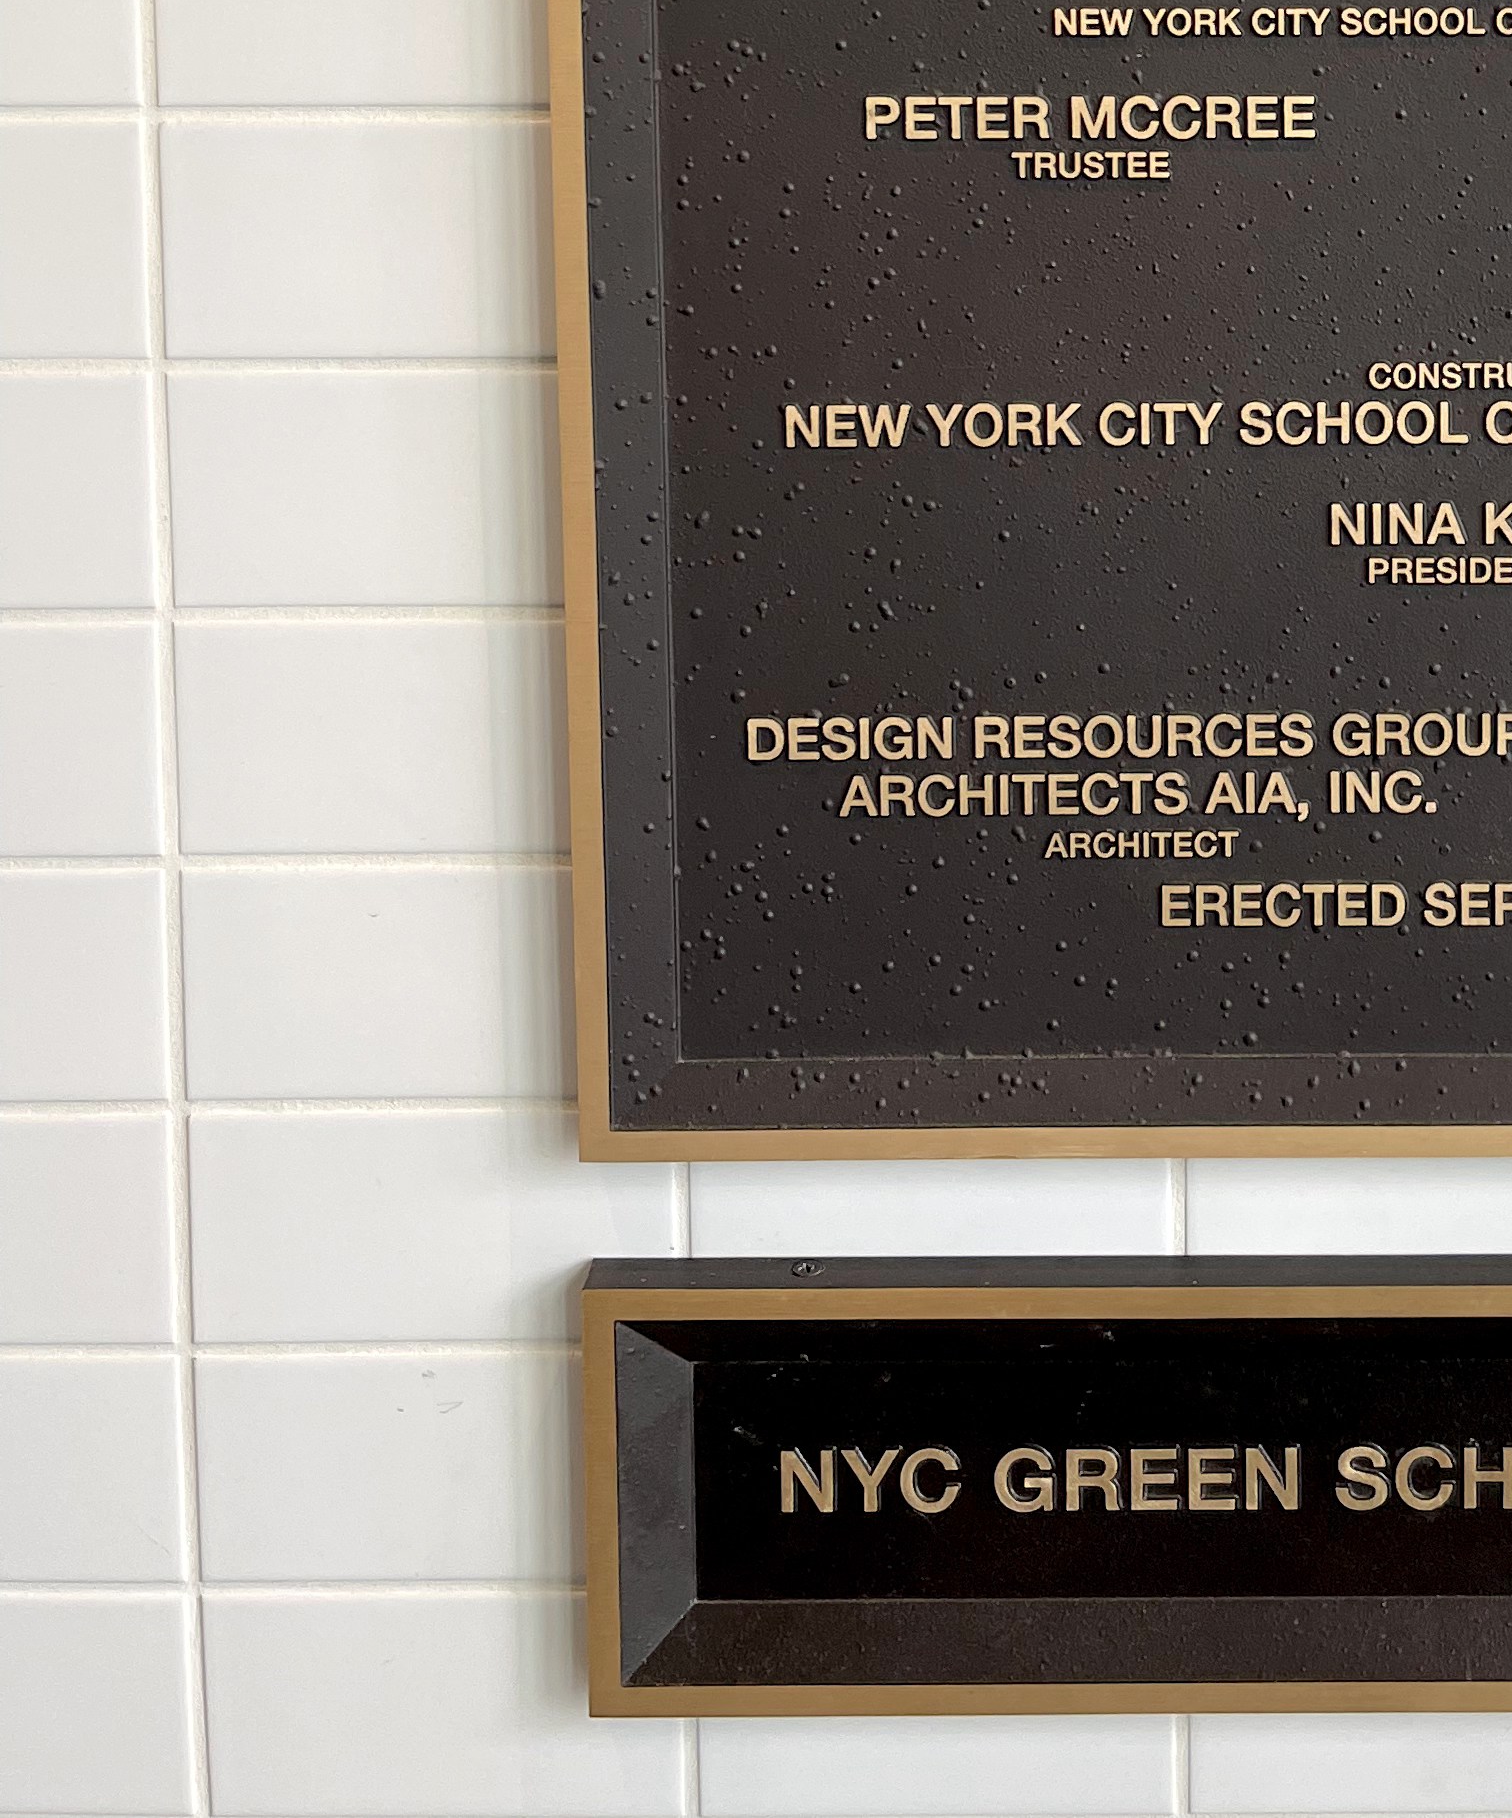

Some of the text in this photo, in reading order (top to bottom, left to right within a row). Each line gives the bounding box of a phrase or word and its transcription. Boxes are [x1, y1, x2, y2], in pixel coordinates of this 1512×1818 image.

[1054, 7, 1134, 36] NEW
[1142, 7, 1242, 37] YORK
[1251, 7, 1331, 36] CITY
[1340, 7, 1486, 36] SCHOOL
[865, 94, 1316, 140] PETER MCCREE
[1010, 151, 1171, 179] TRUSTEE
[785, 404, 912, 448] NEW
[925, 402, 1082, 448] YORK
[1099, 401, 1224, 447] CITY
[1239, 400, 1469, 446] SCHOOL
[1330, 500, 1468, 546] NINA
[746, 717, 953, 761] DESIGN
[974, 714, 1316, 759] RESOURCES
[839, 770, 1437, 822] ARCHITECTS AIA, INC.
[1044, 827, 1240, 859] ARCHITECT
[1161, 882, 1408, 928] ERECTED
[780, 1444, 962, 1514] NYC
[993, 1443, 1301, 1513] GREEN
